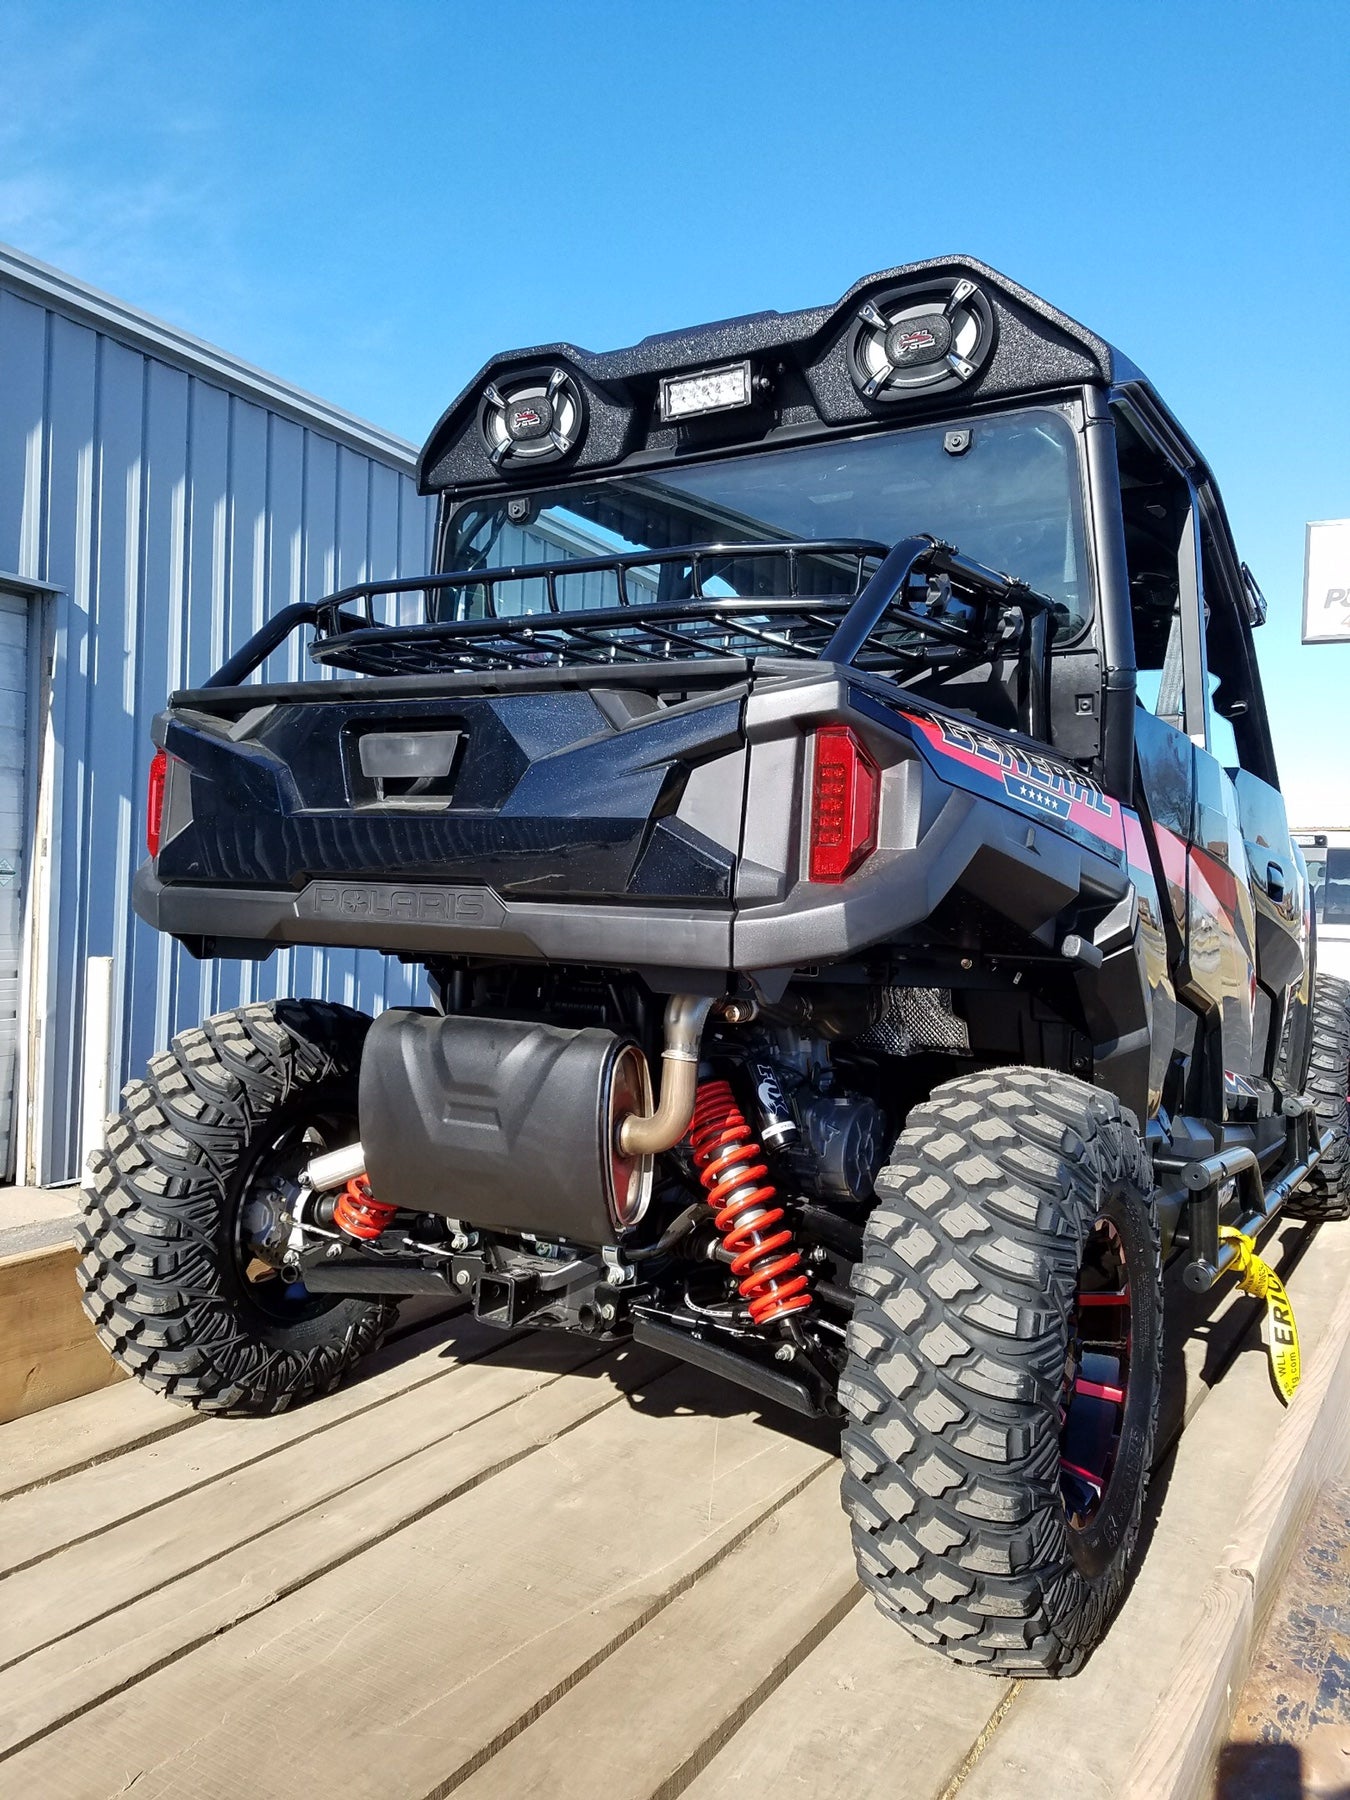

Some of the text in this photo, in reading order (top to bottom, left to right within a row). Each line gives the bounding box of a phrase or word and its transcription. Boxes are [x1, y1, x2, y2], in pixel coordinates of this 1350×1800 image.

[928, 713, 1113, 817] GENERAL
[313, 887, 485, 921] POLARIS
[757, 1064, 789, 1115] FOX
[1268, 1274, 1295, 1346] ERIC
[1276, 1351, 1286, 1378] WLL
